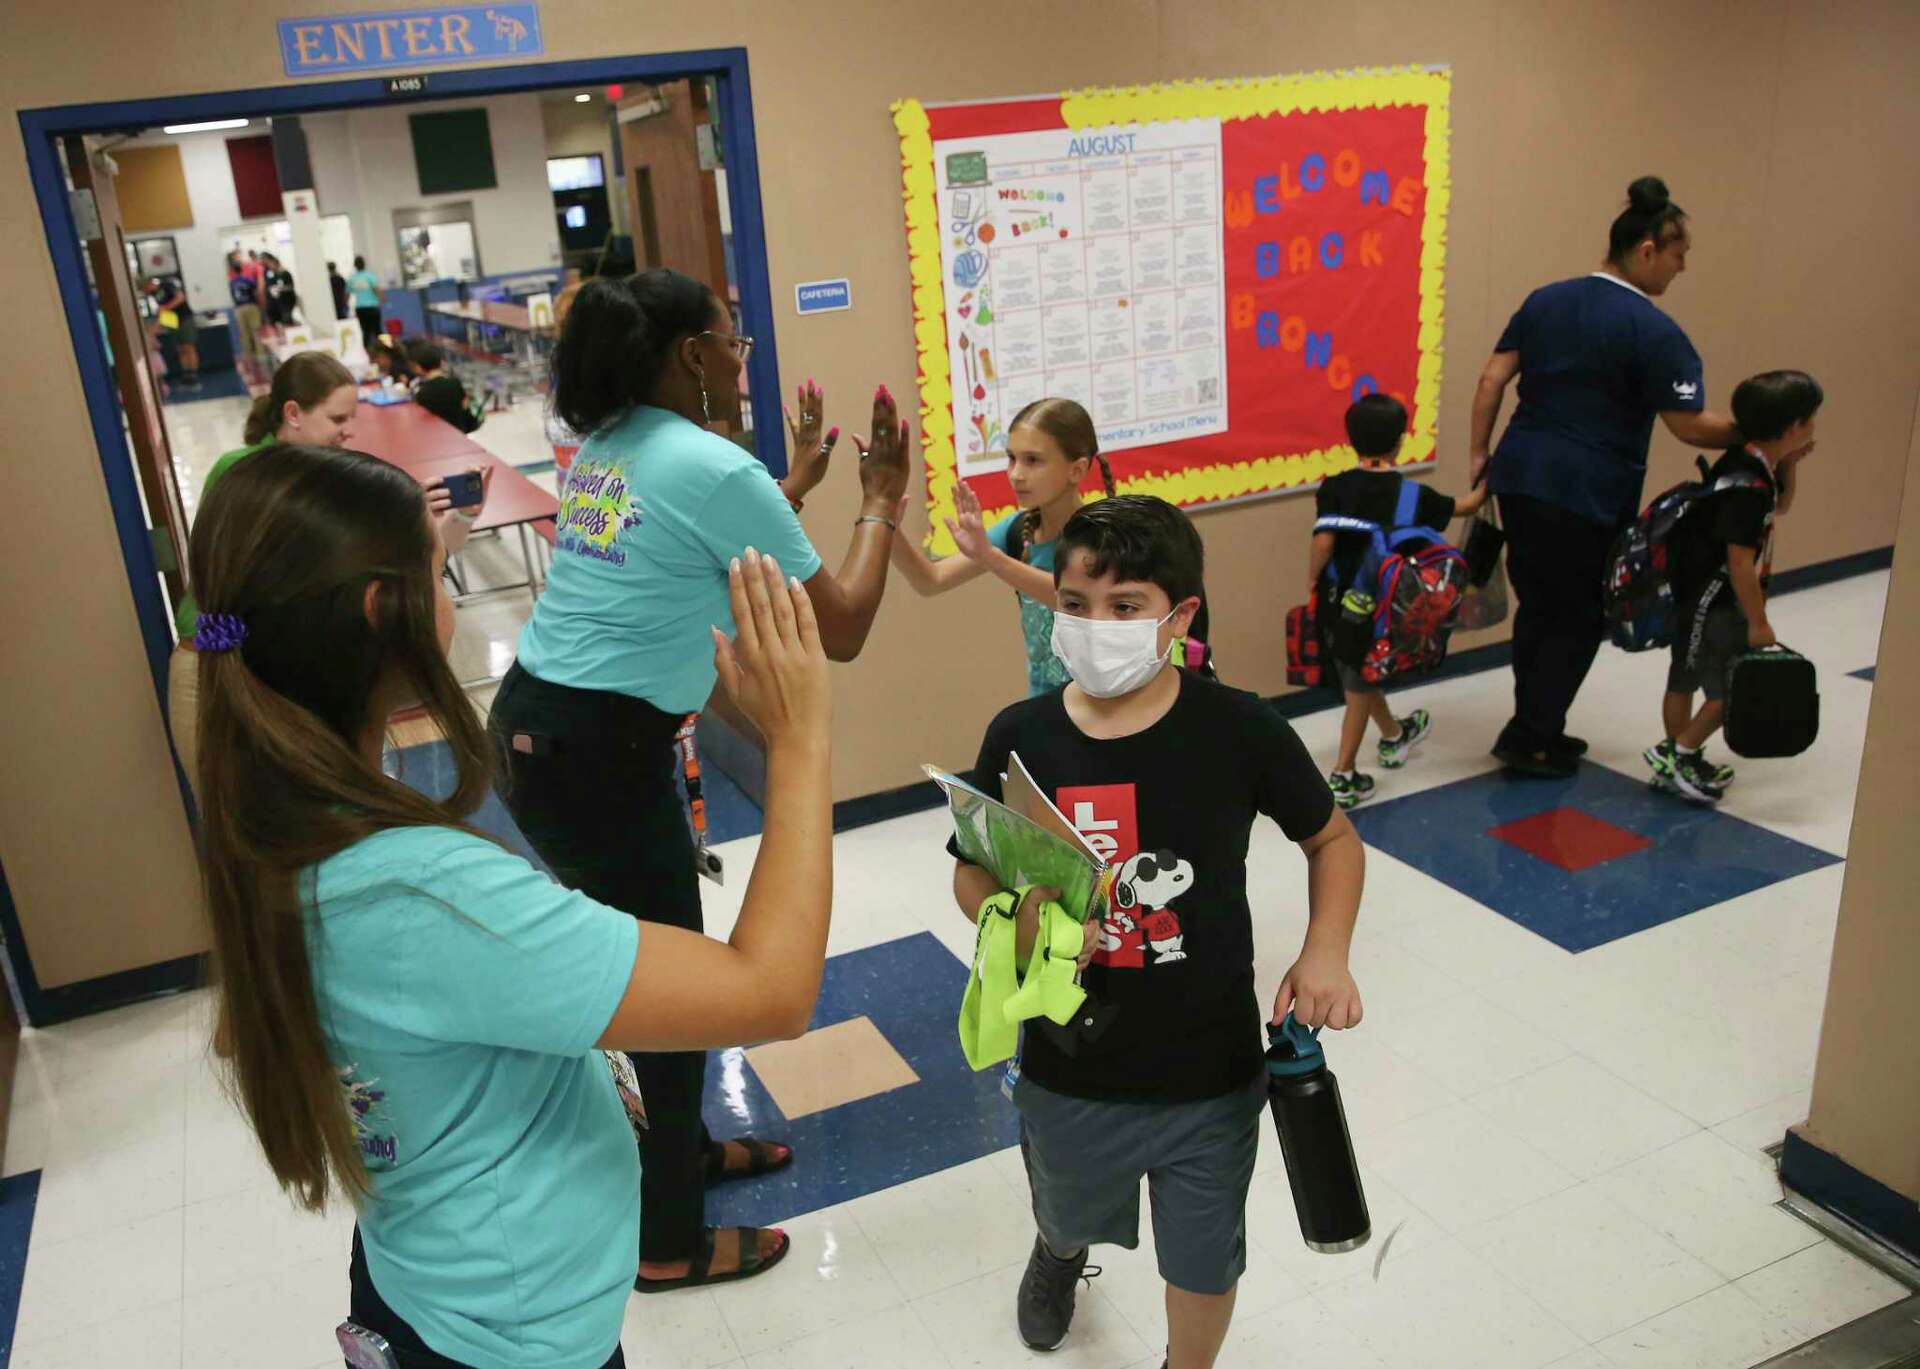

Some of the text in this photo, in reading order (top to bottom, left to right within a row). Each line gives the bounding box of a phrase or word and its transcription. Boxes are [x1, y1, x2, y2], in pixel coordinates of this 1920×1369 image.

[292, 15, 476, 65] ENTER
[1067, 132, 1137, 157] AUGUST
[1225, 150, 1422, 229] WELCOME
[1255, 230, 1383, 279] BACK
[1231, 292, 1407, 404] BRONCO
